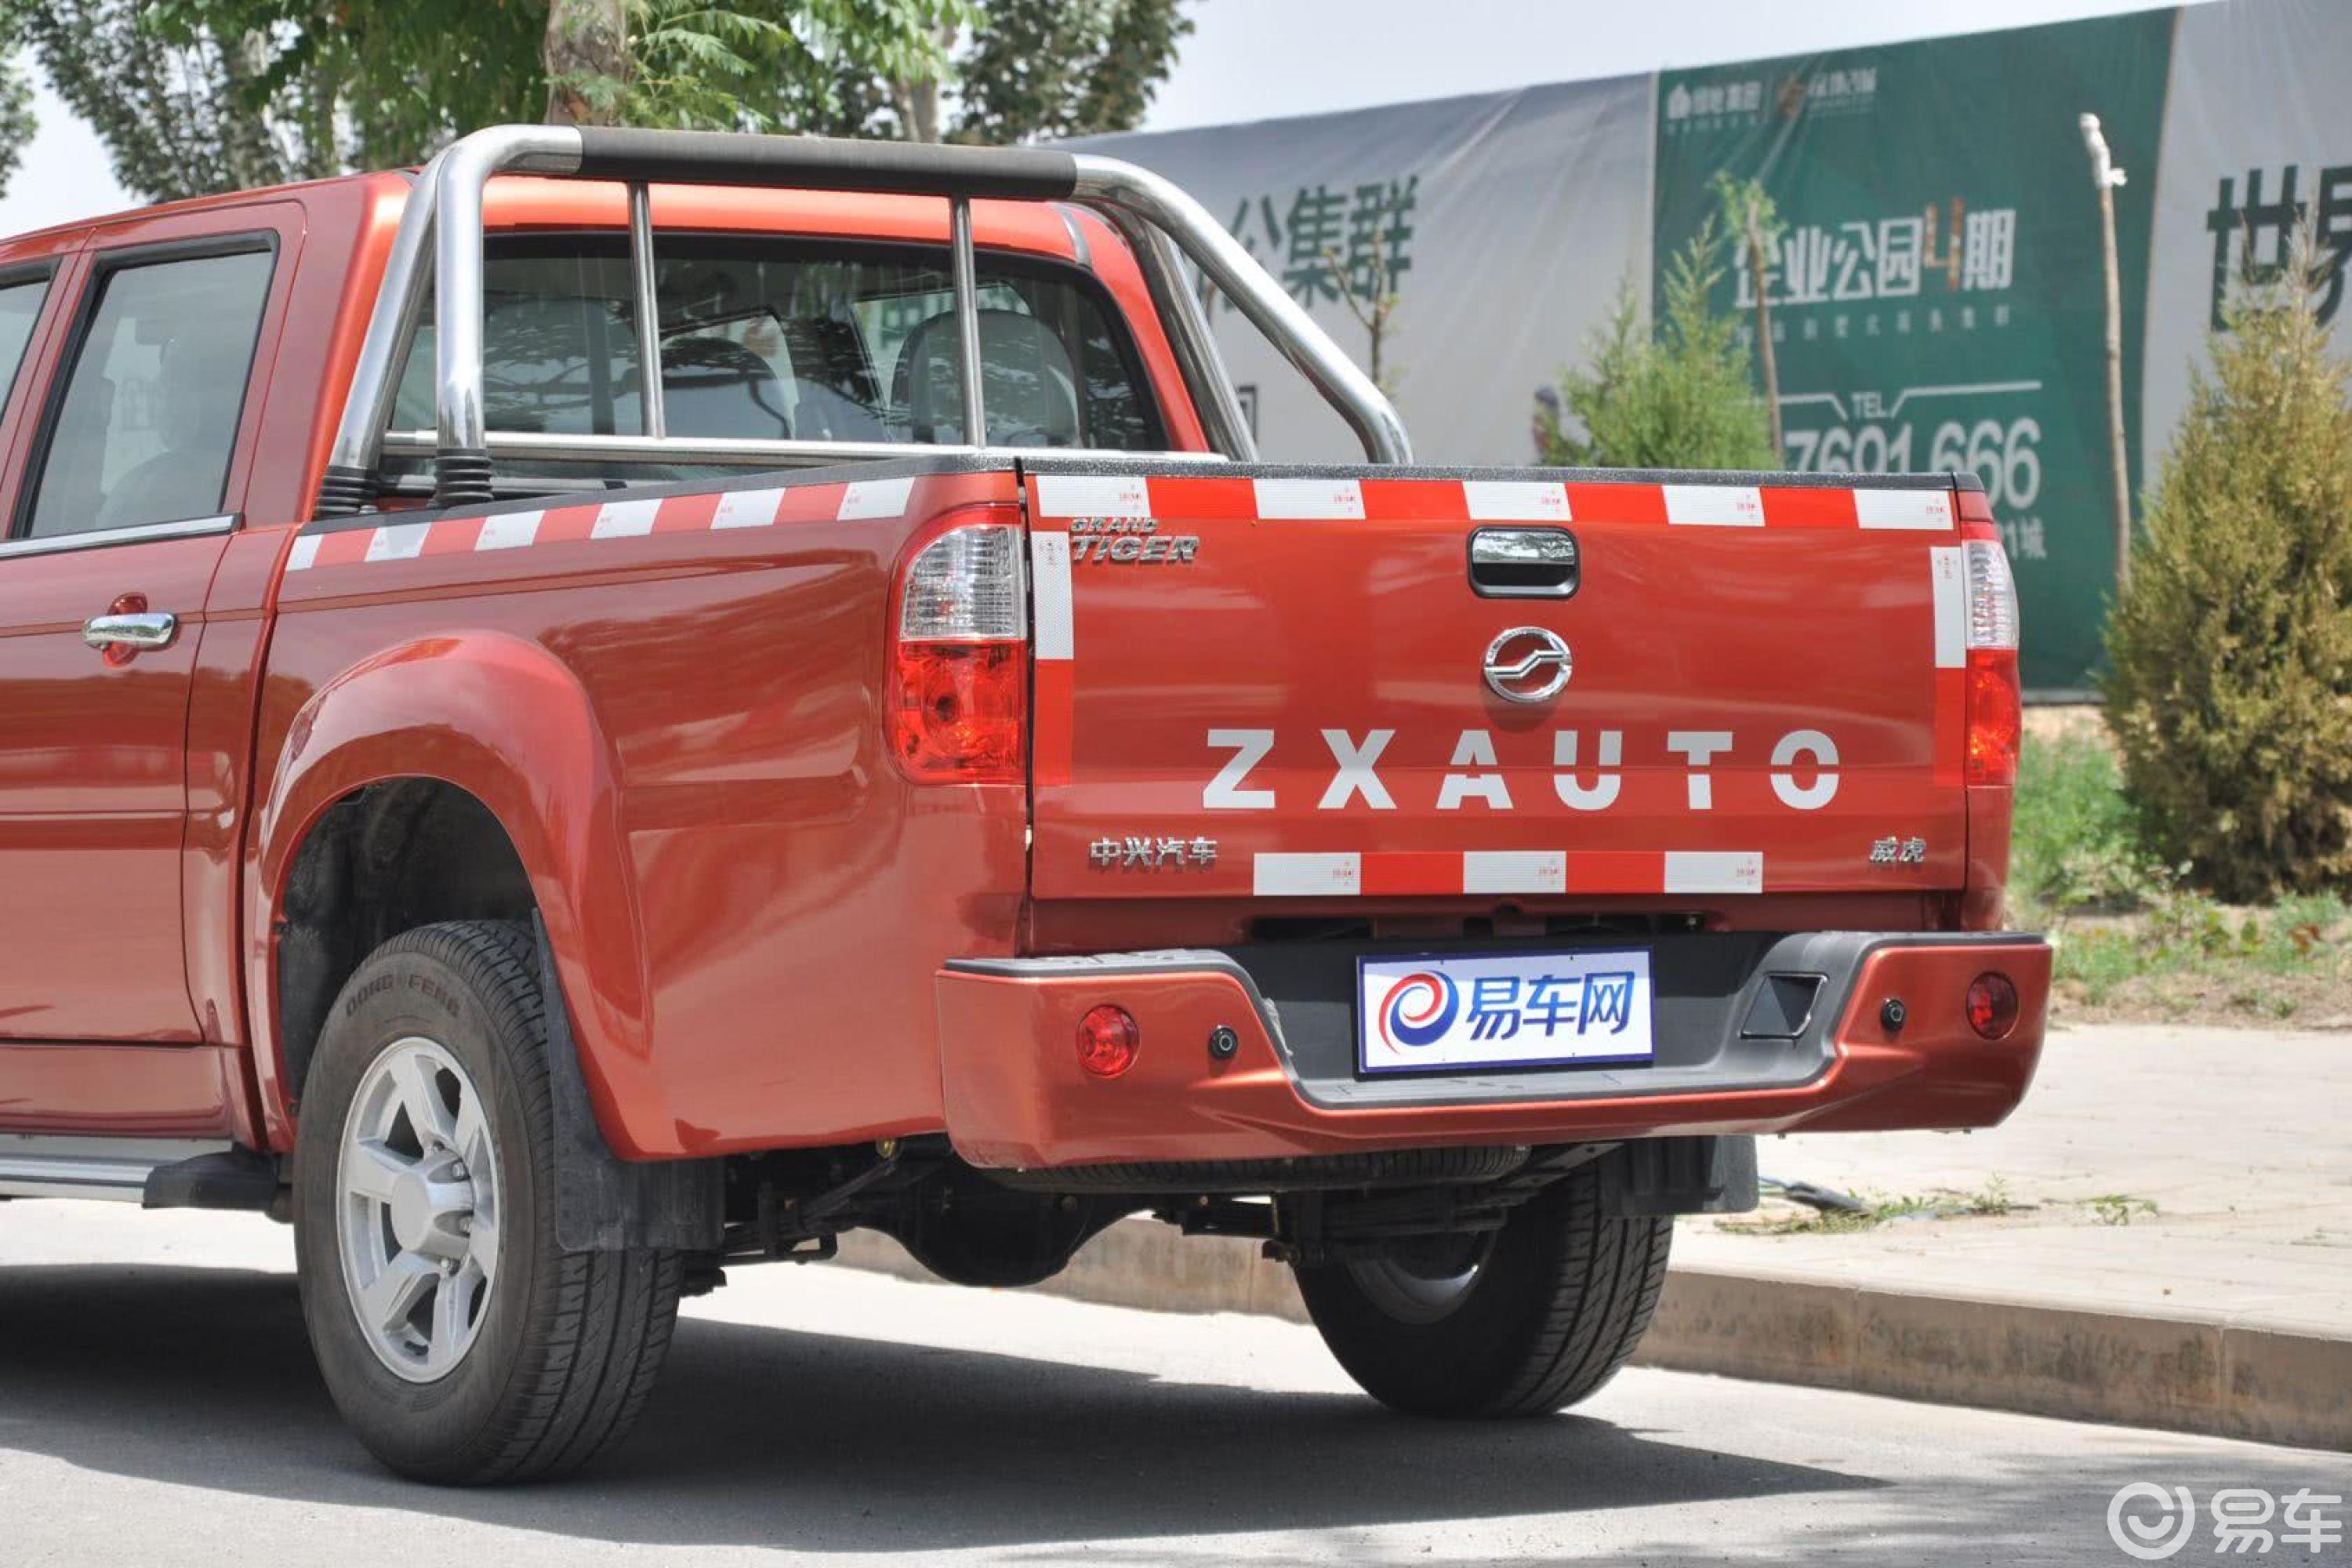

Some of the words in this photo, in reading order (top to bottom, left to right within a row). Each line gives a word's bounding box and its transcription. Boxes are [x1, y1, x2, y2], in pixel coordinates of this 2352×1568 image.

[1851, 392, 1887, 418] TEL
[1070, 517, 1159, 533] GRAND
[1071, 535, 1200, 562] TIGER
[1203, 728, 1840, 811] ZXAUTO
[1090, 837, 1218, 867] 中兴汽车
[1869, 837, 1927, 864] 威虎
[1465, 971, 1635, 1041] 易车网
